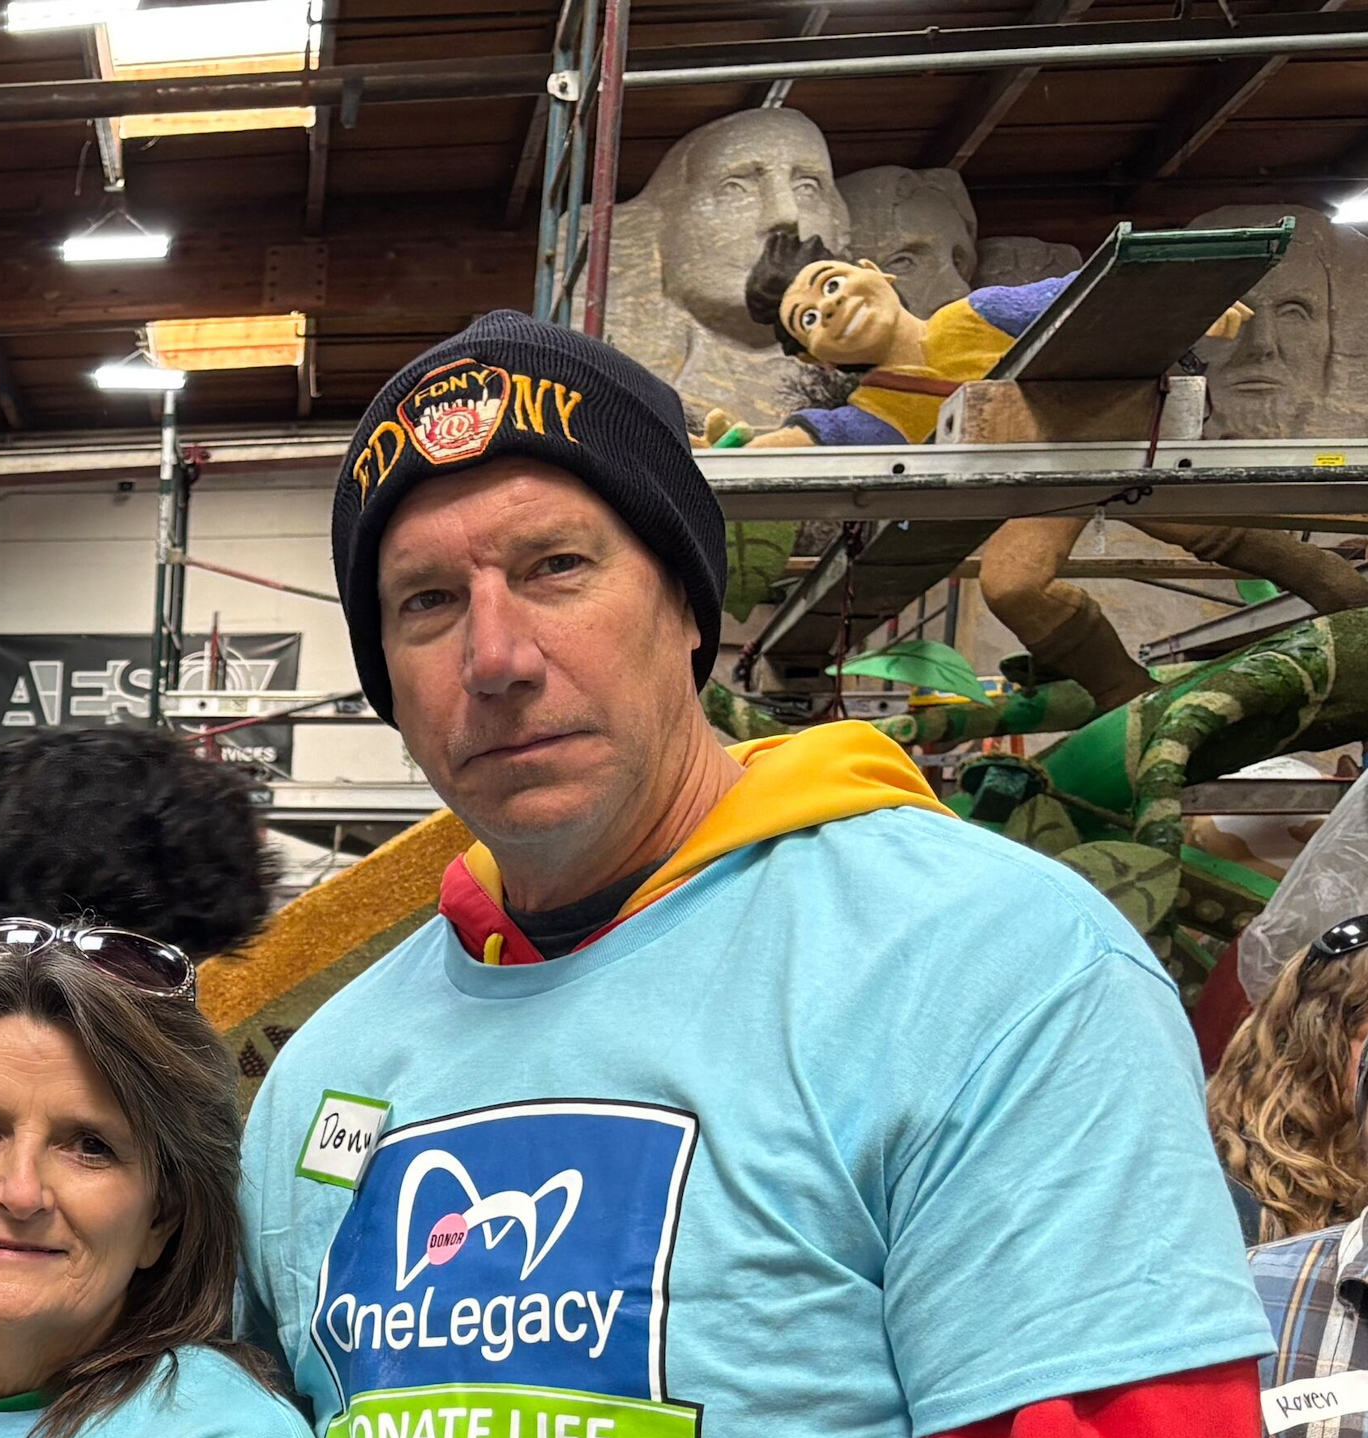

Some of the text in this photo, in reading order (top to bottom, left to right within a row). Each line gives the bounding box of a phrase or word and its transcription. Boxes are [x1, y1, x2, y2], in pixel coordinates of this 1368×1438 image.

[430, 1232, 464, 1248] DONOR
[326, 1286, 625, 1362] OneLegacy
[1276, 1391, 1339, 1419] Karen
